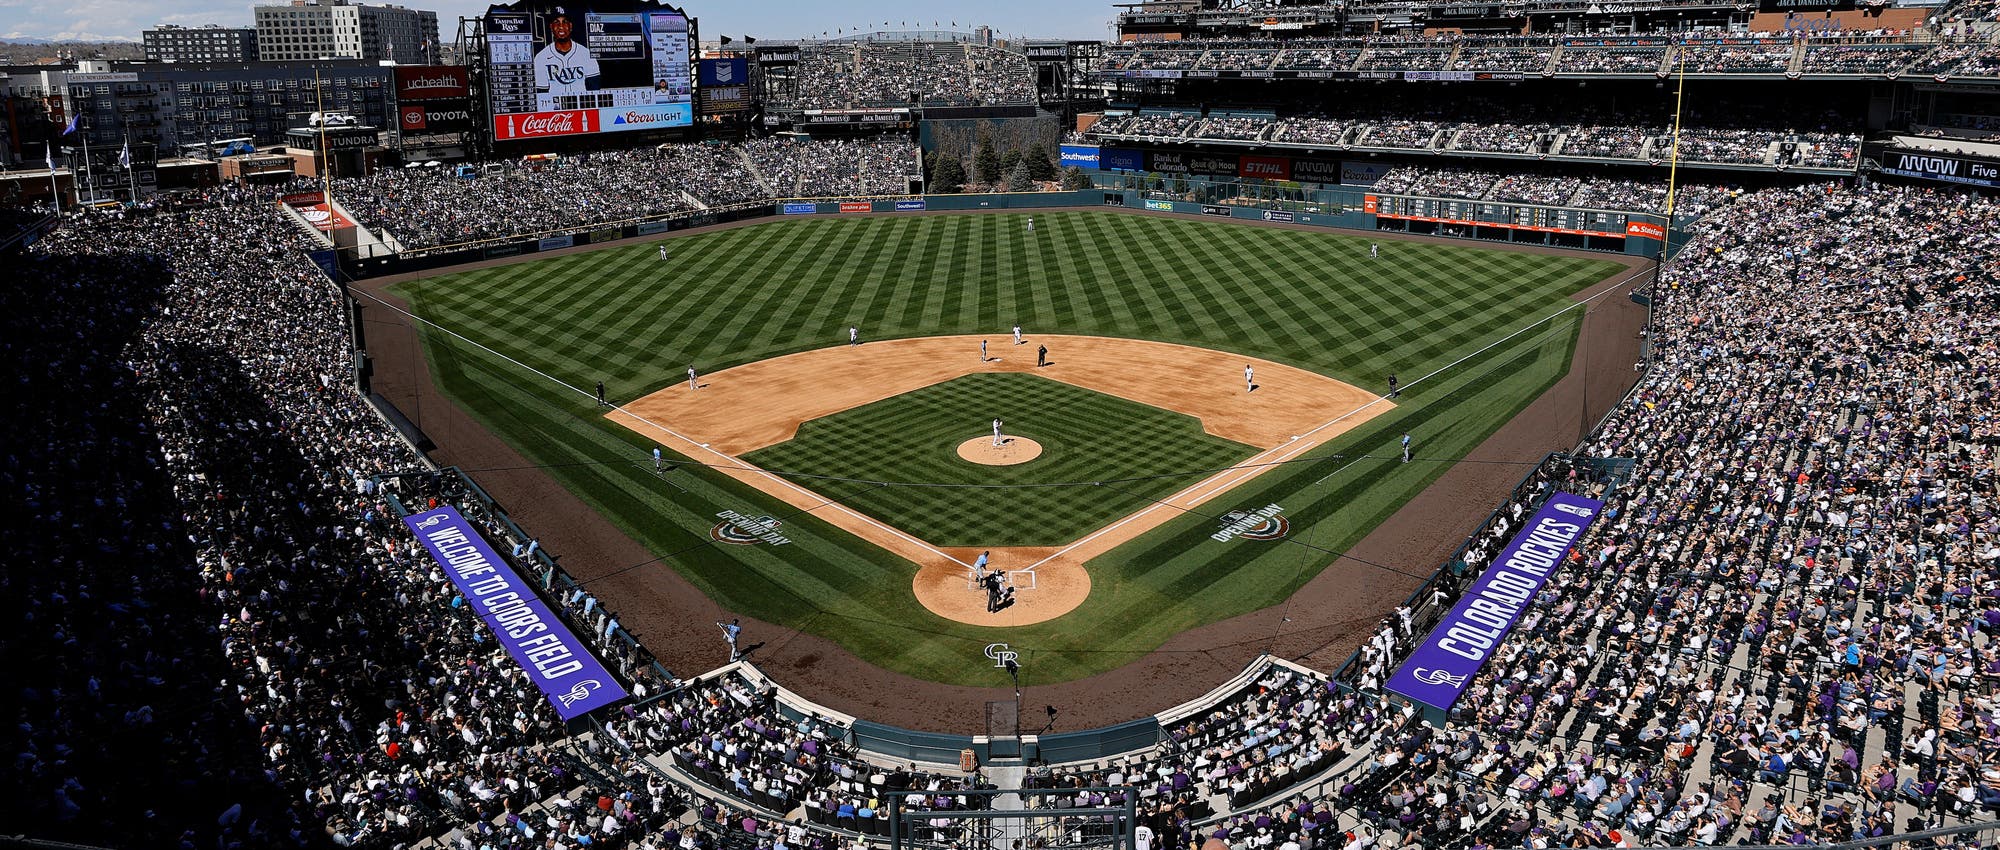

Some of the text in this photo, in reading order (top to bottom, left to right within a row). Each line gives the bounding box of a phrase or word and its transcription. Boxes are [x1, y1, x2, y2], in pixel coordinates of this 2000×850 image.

[1443, 7, 1458, 15] JACK
[1603, 4, 1634, 13] Silver
[1784, 13, 1840, 31] Coors
[589, 23, 605, 33] DIAZ
[760, 52, 772, 61] JACK
[1027, 47, 1039, 56] JACK
[545, 64, 584, 84] RAYS
[407, 74, 457, 89] uchealth
[710, 87, 741, 100] KING
[425, 111, 469, 121] TOYOTA
[626, 111, 681, 124] Coors LIGHT
[861, 114, 873, 122] JACK
[332, 136, 375, 146] TUNDRA
[1061, 152, 1095, 162] Southwest
[1110, 156, 1132, 166] cigna
[1153, 154, 1181, 162] Bank of
[1153, 162, 1188, 172] Colorado
[1190, 159, 1236, 170] BLUE MOON
[1245, 162, 1283, 174] STIHL
[1295, 161, 1334, 173] ARROW
[1899, 155, 1958, 175] ARROW
[1343, 169, 1370, 180] Coors
[1971, 164, 1998, 178] Five
[1146, 202, 1172, 210] bet365
[1210, 503, 1285, 543] OPENING DAY
[1437, 517, 1581, 661] COLORADO ROCKIES
[427, 525, 584, 680] WELCOME TO COORS FIELD
[1139, 833, 1147, 841] 17
